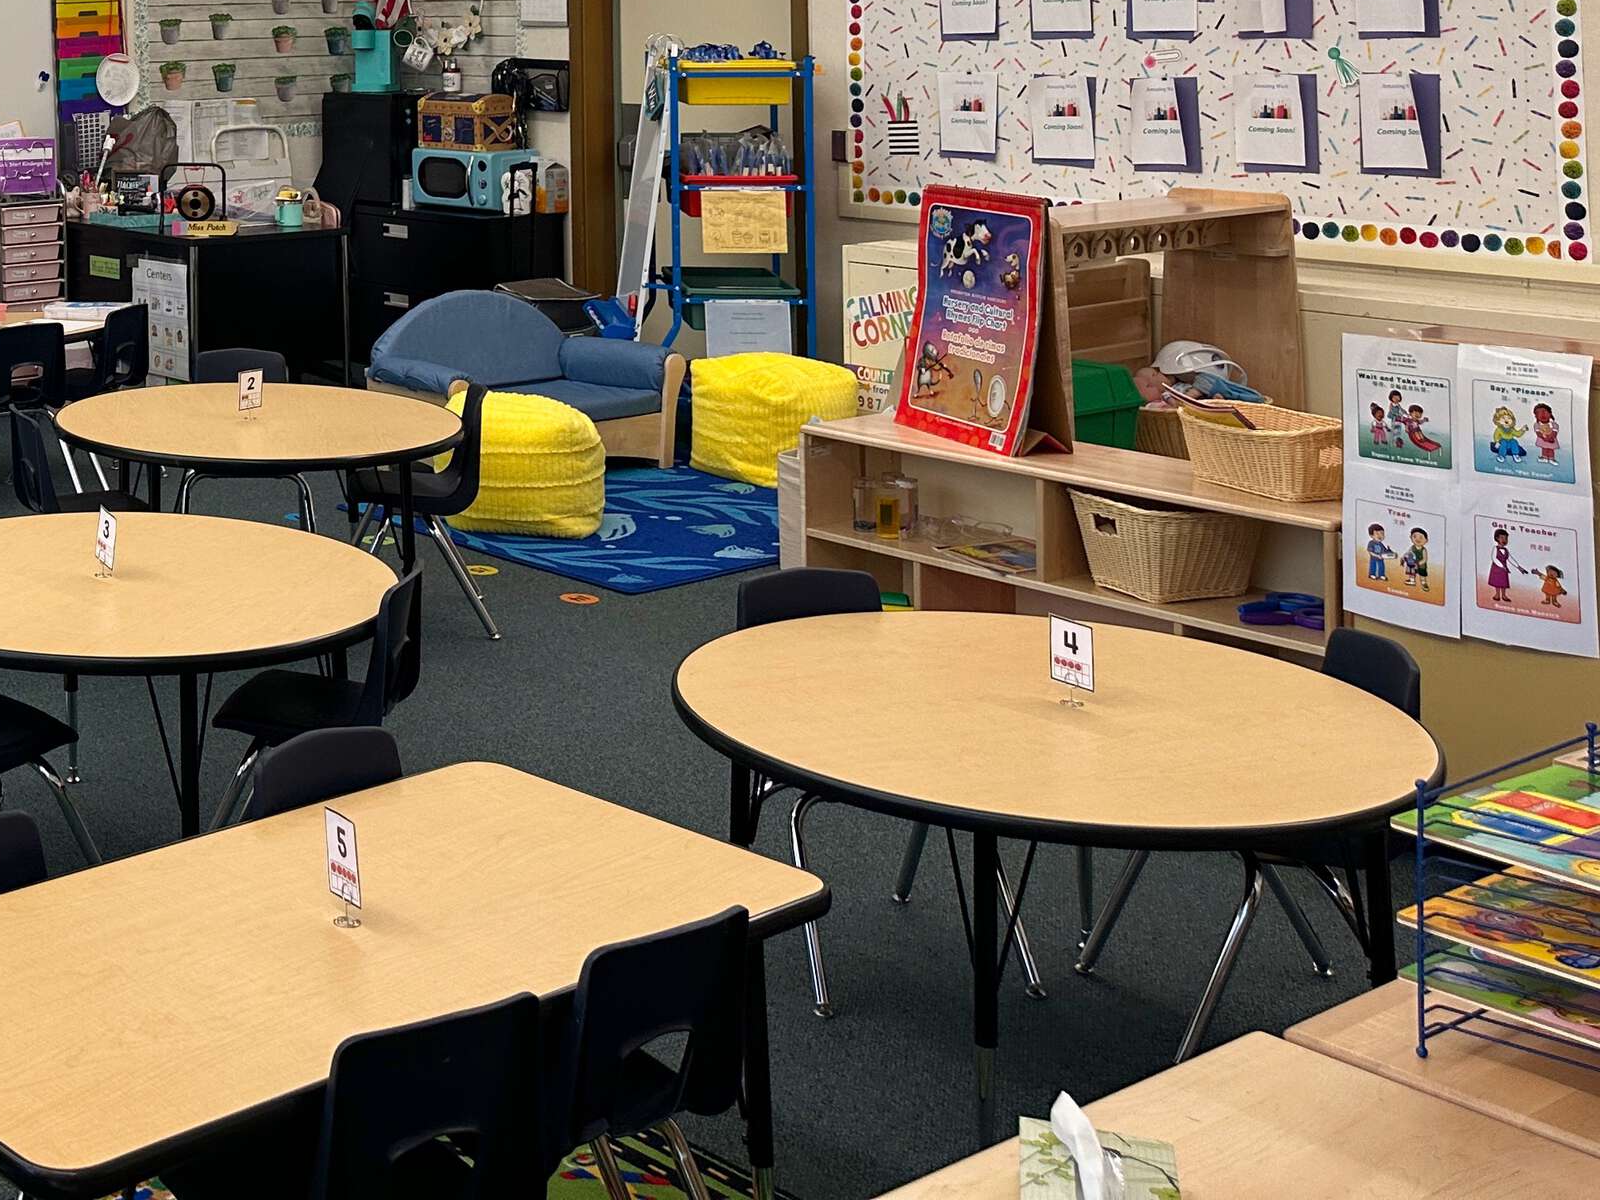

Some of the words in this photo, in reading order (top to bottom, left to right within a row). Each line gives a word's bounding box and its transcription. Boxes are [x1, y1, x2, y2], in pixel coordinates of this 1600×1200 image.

[1248, 126, 1275, 134] Coming
[187, 223, 204, 231] Miss
[206, 223, 226, 231] Patch
[146, 266, 173, 282] Centers
[943, 295, 970, 312] Nursery
[970, 302, 984, 314] and
[985, 304, 1014, 320] Cultural
[946, 308, 972, 323] Rhymes
[972, 313, 985, 328] Flip
[985, 317, 1007, 331] Chart
[857, 367, 890, 383] COUNT
[1358, 372, 1377, 380] Wait
[1396, 376, 1417, 385] Take
[247, 376, 255, 390] 2
[858, 395, 865, 407] 9
[867, 397, 873, 409] 8
[875, 398, 882, 410] 7
[1387, 508, 1411, 519] Trade
[103, 520, 110, 538] 3
[1519, 525, 1557, 537] Teacher
[1063, 630, 1079, 655] 4
[336, 826, 347, 858] 5
